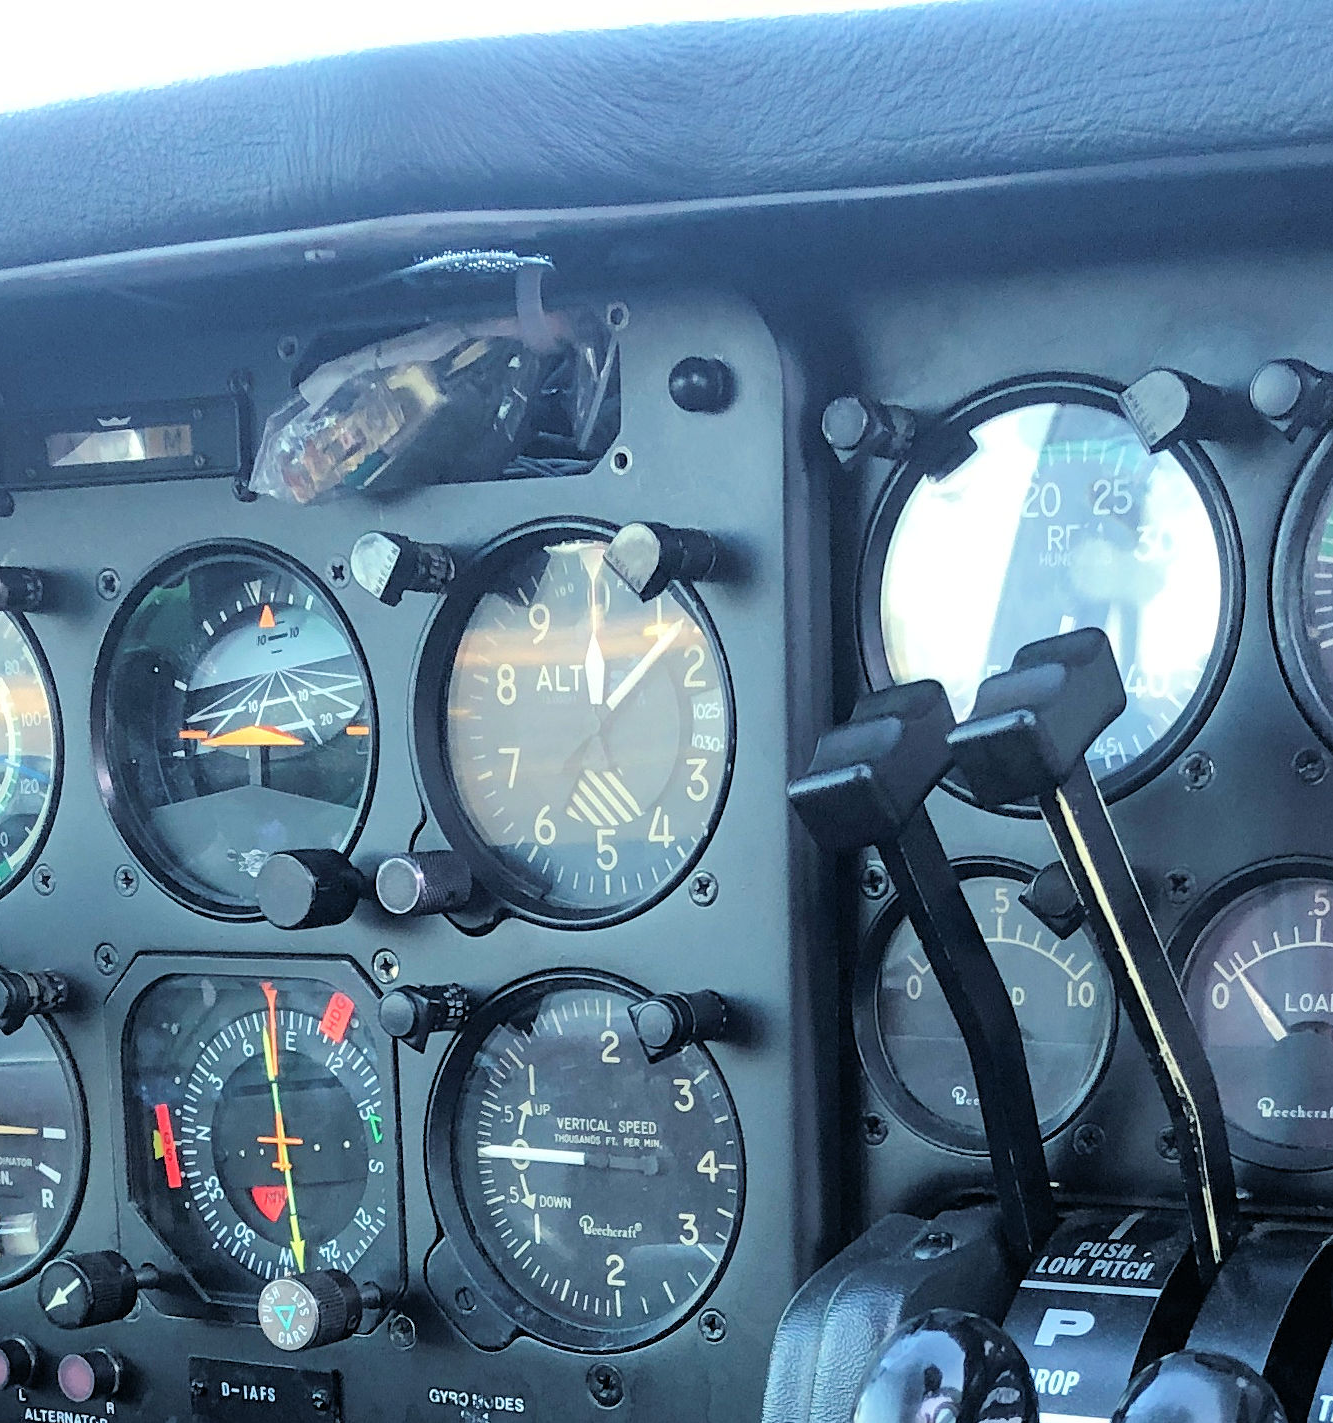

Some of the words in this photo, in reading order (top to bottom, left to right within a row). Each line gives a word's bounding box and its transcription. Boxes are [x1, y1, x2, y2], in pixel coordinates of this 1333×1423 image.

[1092, 480, 1133, 515] 25
[527, 603, 550, 644] 9
[496, 665, 517, 705] 8
[536, 665, 582, 692] ALT
[684, 649, 706, 687] 2
[497, 748, 520, 789] 7
[686, 761, 709, 801] 3
[534, 804, 556, 845] 6
[596, 829, 619, 871] 5
[648, 809, 675, 849] 4
[534, 1102, 551, 1116] UP
[556, 1118, 612, 1135] VERTICAL
[618, 1120, 657, 1135] SPEED
[554, 1133, 602, 1146] THOUSANDS
[621, 1138, 637, 1148] PER
[539, 1196, 572, 1209] DOWN
[1074, 1241, 1136, 1260] PUSH
[1035, 1256, 1080, 1275] LOW
[1088, 1259, 1155, 1280] PITCH
[1034, 1309, 1095, 1347] P
[221, 1382, 277, 1403] D-IAFS
[1030, 1368, 1080, 1397] ROP
[428, 1388, 469, 1407] GYRO
